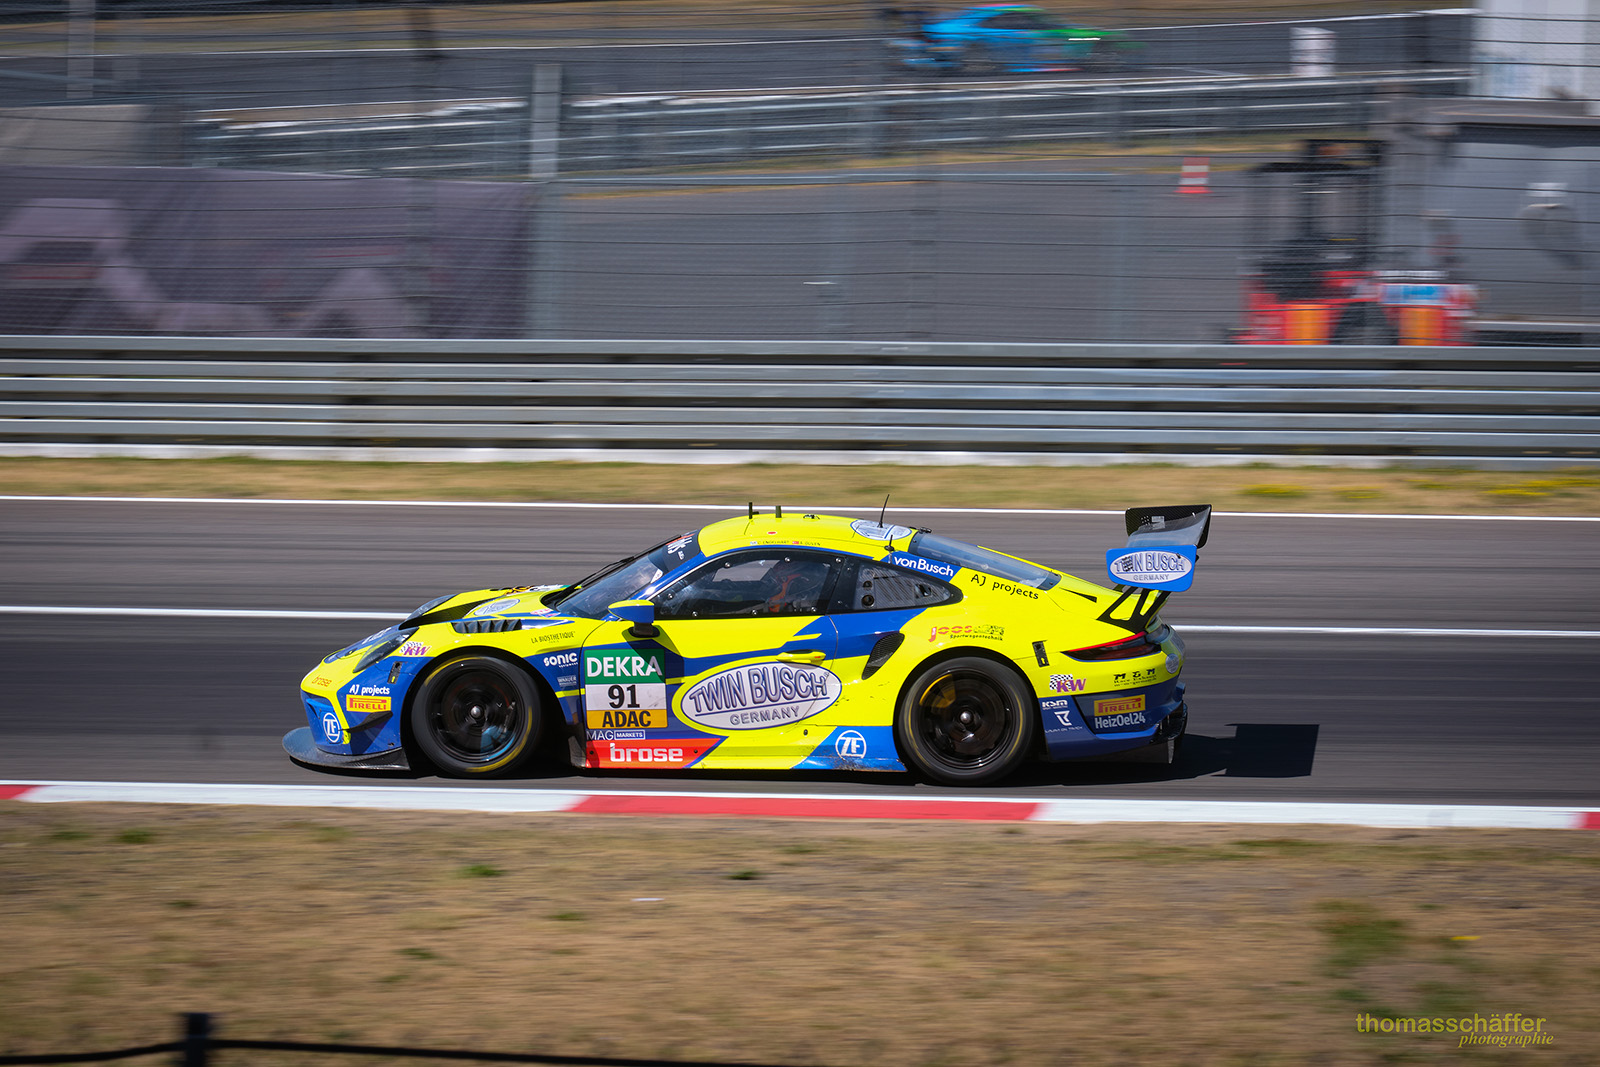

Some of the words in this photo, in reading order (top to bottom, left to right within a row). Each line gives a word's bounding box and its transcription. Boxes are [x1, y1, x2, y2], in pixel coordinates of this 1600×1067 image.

[894, 555, 954, 577] vonBusch
[1145, 552, 1184, 572] BUSCH
[970, 573, 986, 587] AJ
[992, 579, 1039, 600] projects
[403, 645, 431, 656] KW
[586, 655, 663, 677] DEKRA
[349, 684, 360, 694] AJ
[361, 685, 390, 696] projects
[689, 670, 747, 713] TWIN
[748, 666, 828, 704] BUSCH
[1056, 678, 1087, 693] KW
[349, 697, 387, 710] PIRELLI
[607, 684, 640, 709] 91
[1098, 697, 1142, 713] PIRELLI
[602, 710, 652, 728] ADAC
[729, 705, 800, 726] GERMANY
[1095, 712, 1146, 729] HeizOel24
[586, 730, 614, 740] MAG
[610, 743, 683, 762] brose
